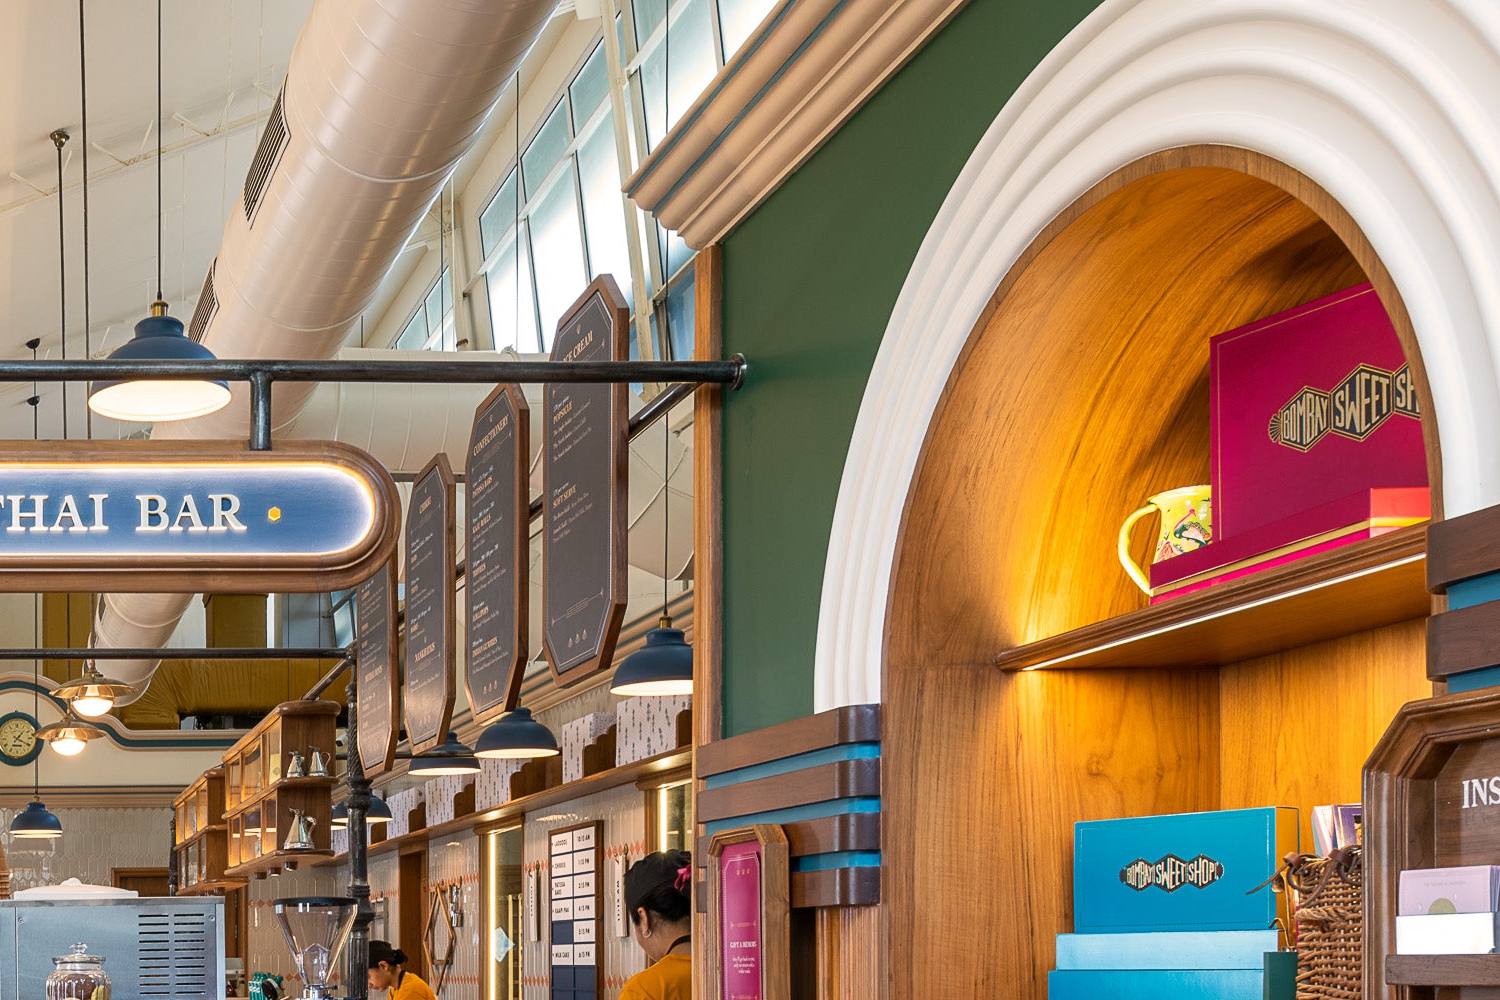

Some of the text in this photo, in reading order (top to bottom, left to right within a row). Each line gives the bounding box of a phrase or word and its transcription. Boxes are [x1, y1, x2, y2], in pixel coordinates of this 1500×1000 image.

[573, 330, 593, 359] CREAM
[1283, 393, 1329, 444] BOMBAY
[1335, 373, 1390, 434] SWEET
[473, 414, 509, 456] CONFECTIONERY
[135, 493, 247, 532] BAR
[1461, 776, 1500, 809] INS
[1126, 857, 1215, 890] BOMBAY SWEET SHOP
